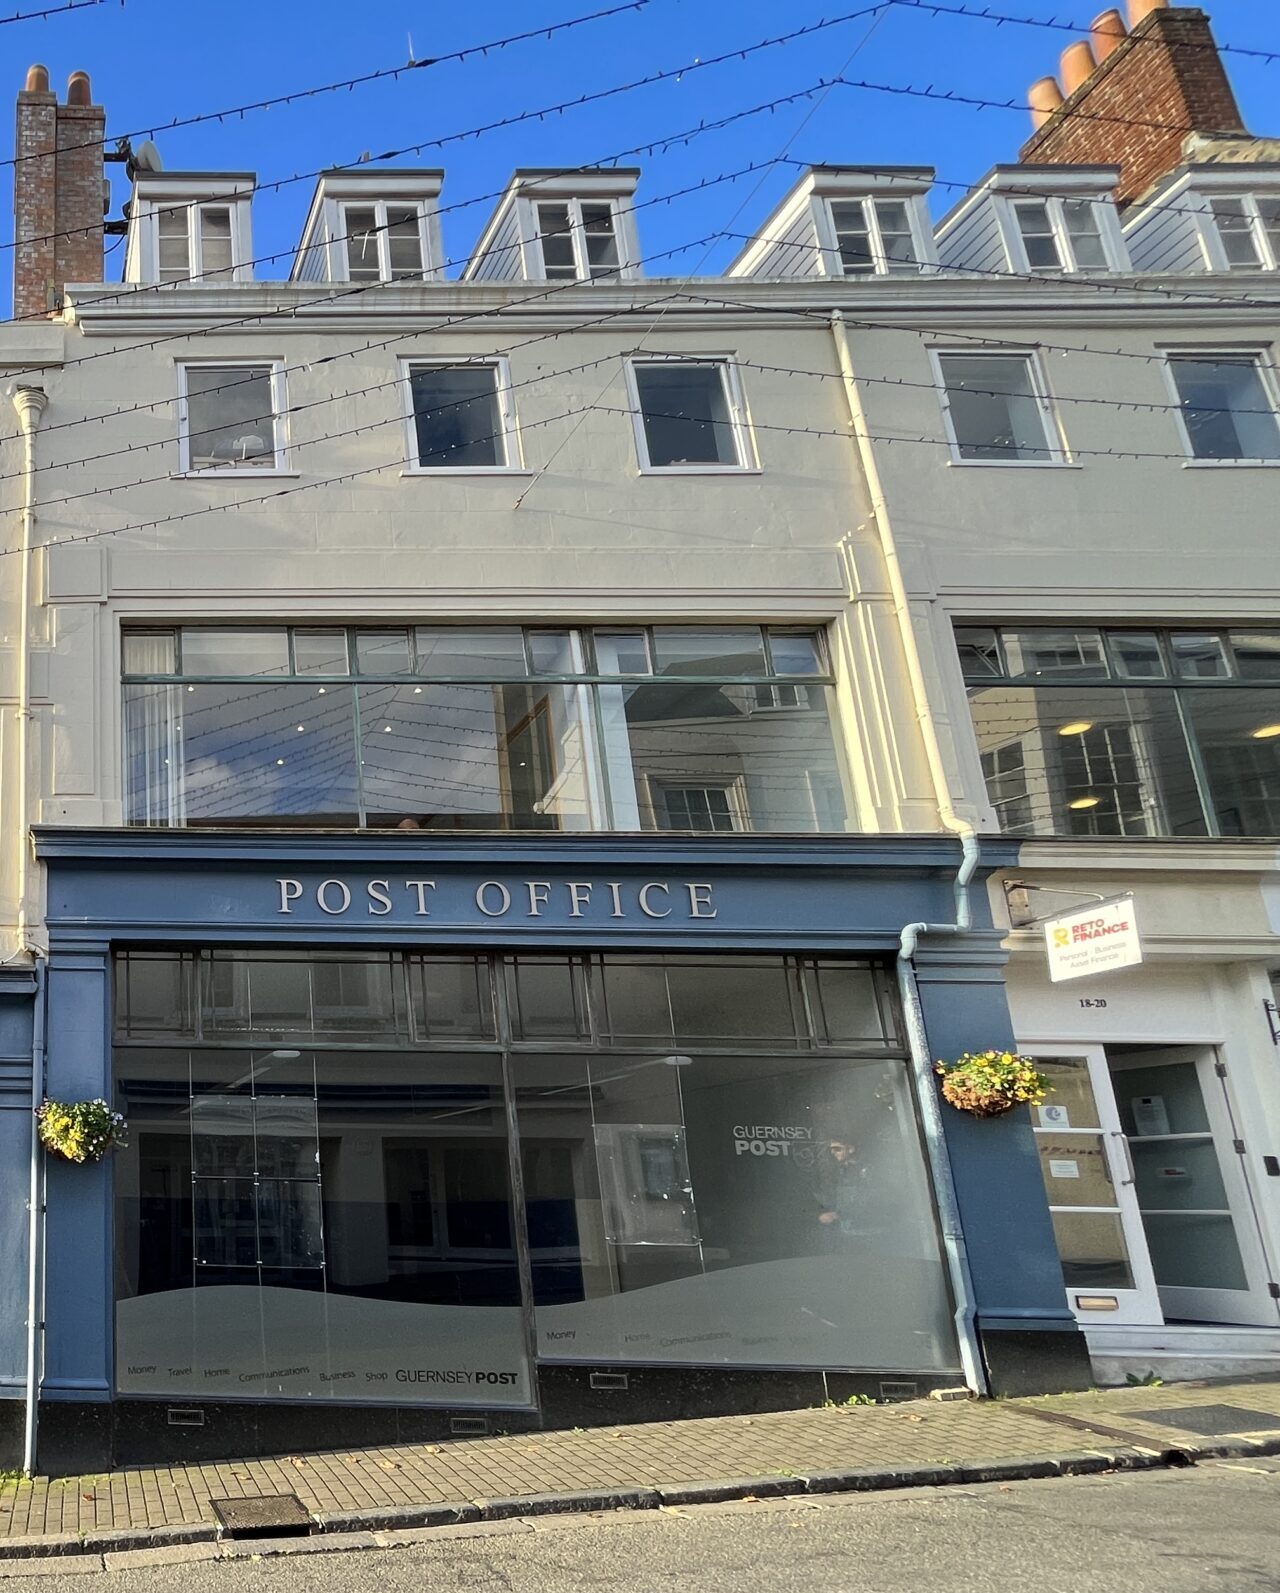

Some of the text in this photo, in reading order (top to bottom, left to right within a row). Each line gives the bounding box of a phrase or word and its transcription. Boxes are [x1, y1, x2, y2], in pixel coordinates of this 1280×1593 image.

[276, 878, 718, 919] POST OFFICE
[1072, 919, 1105, 934] RETO
[1073, 921, 1129, 943] FINANCE
[1079, 999, 1107, 1008] 18-20
[733, 1125, 813, 1139] GUERNSEY
[734, 1140, 790, 1156] POST
[546, 1330, 576, 1341] Money
[127, 1365, 388, 1382] Money Travel Home Communications Business Shop
